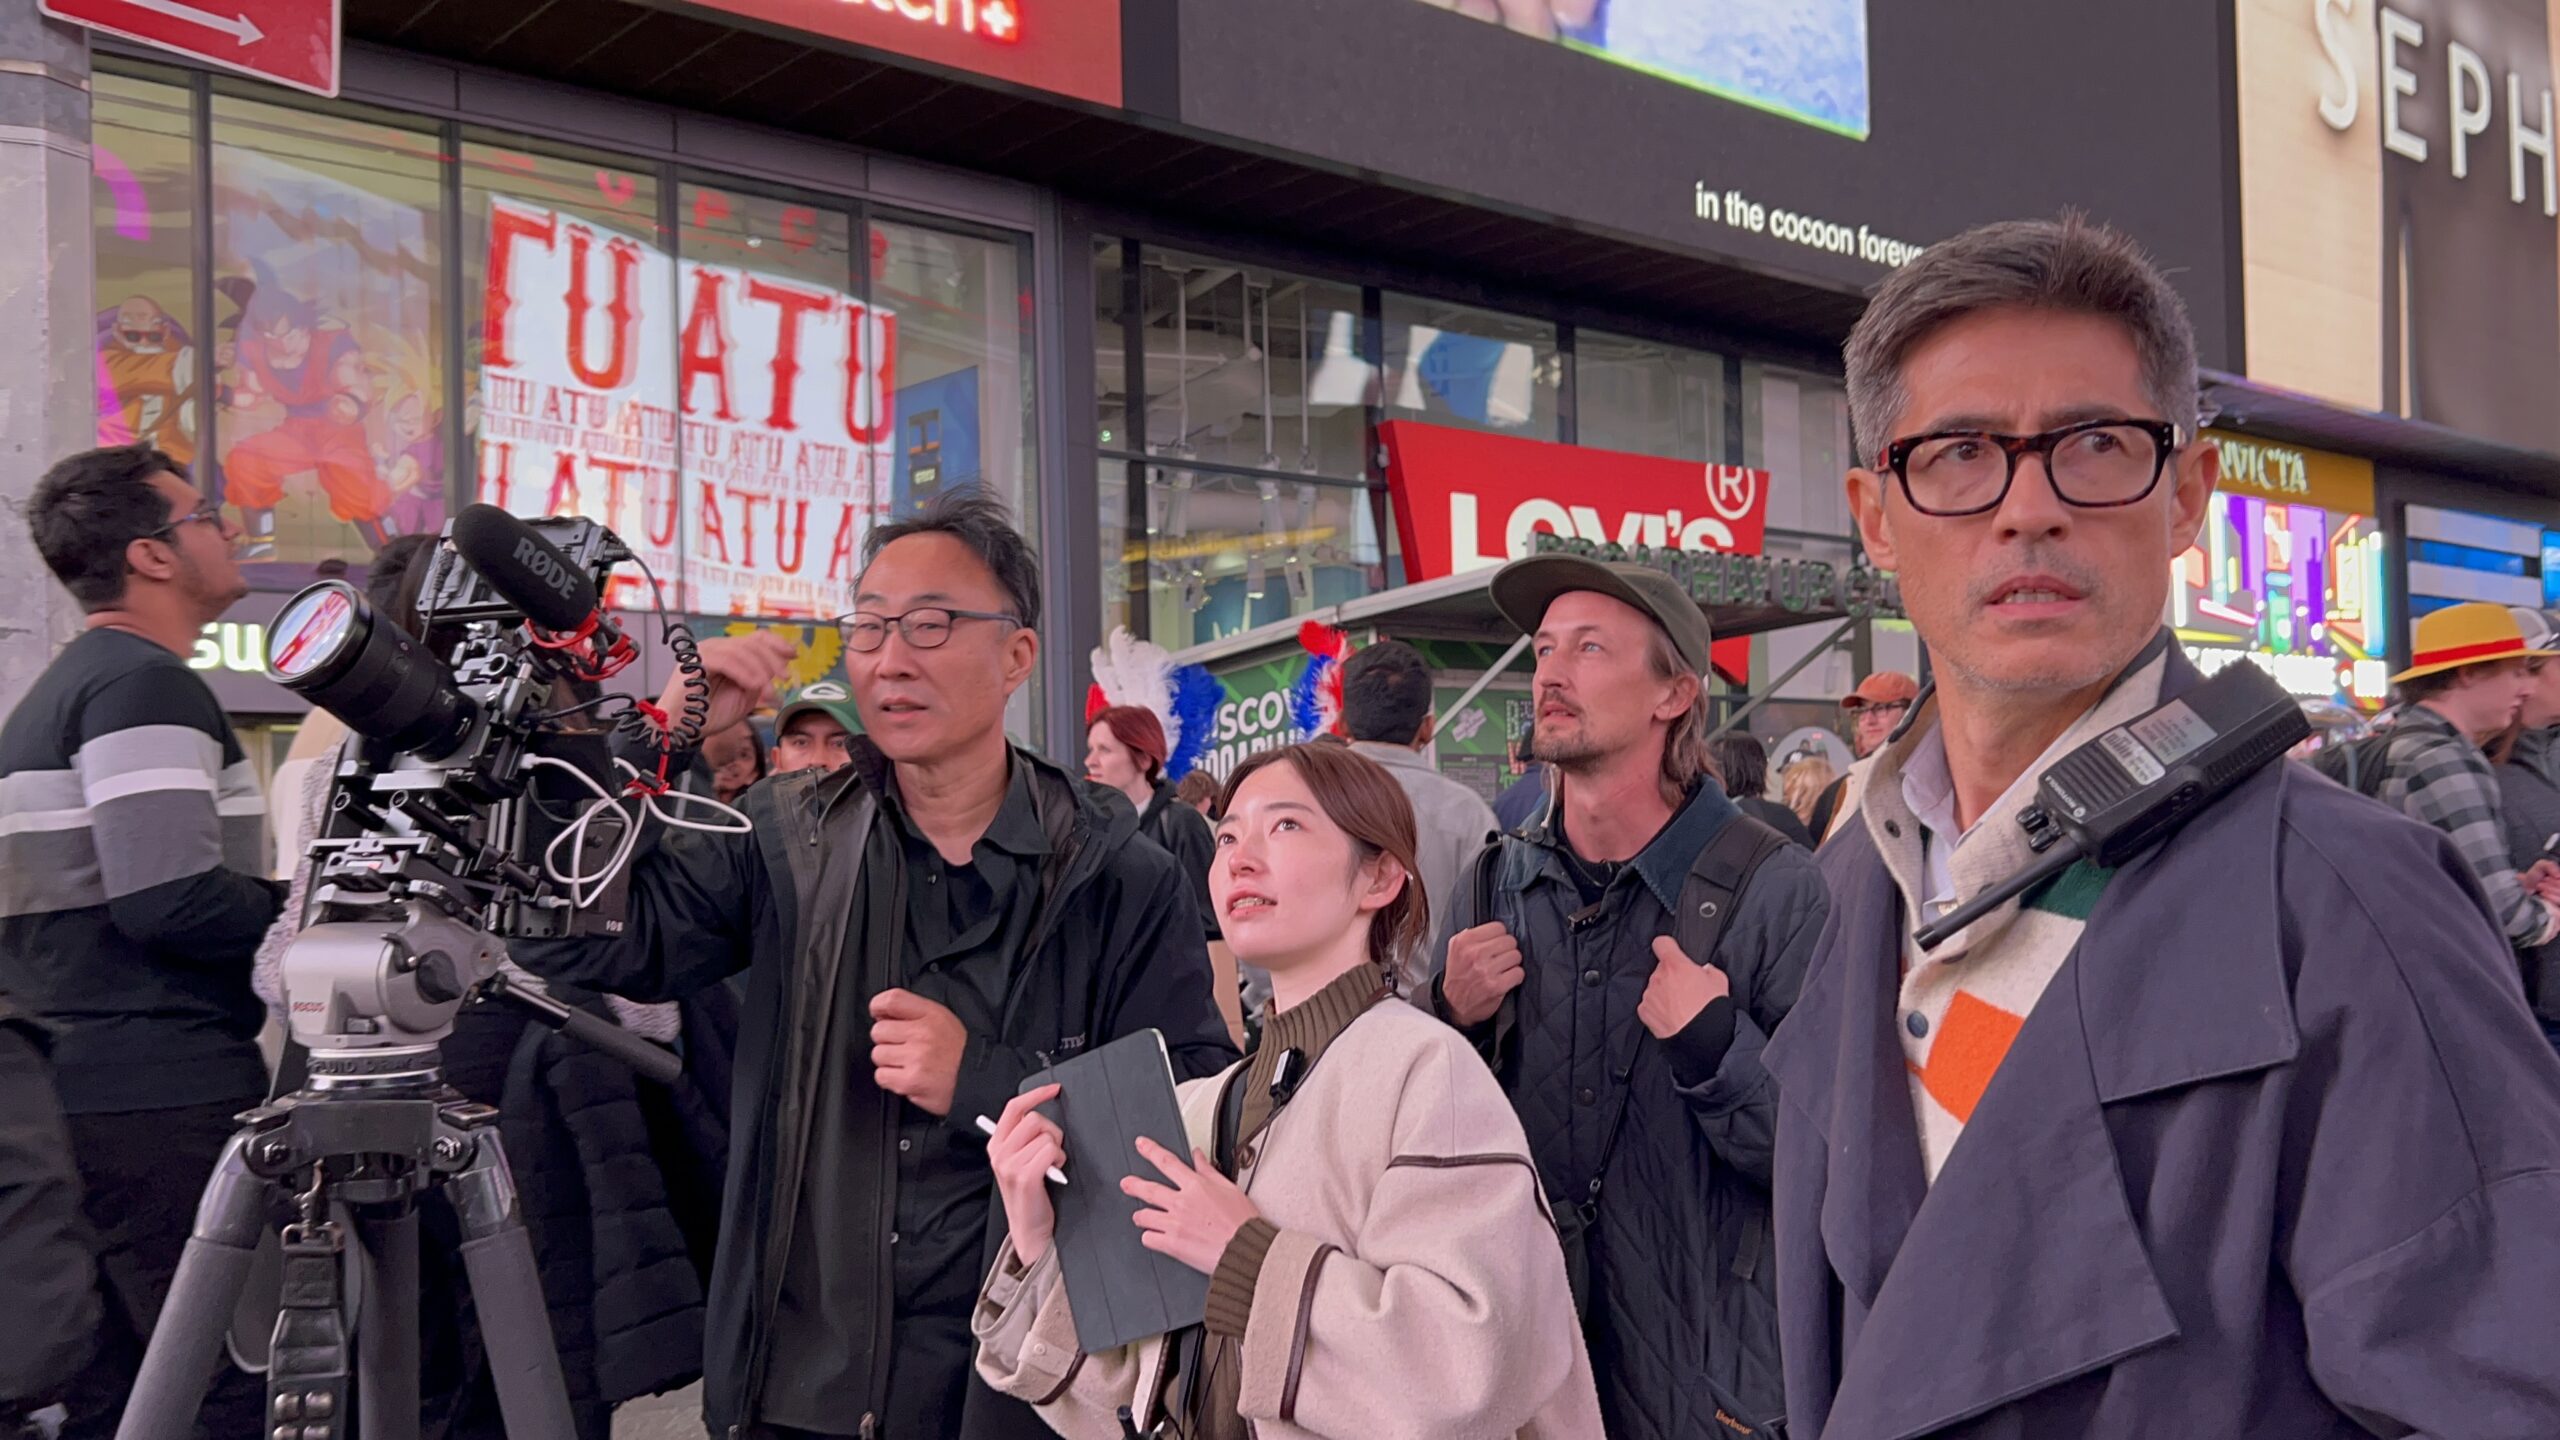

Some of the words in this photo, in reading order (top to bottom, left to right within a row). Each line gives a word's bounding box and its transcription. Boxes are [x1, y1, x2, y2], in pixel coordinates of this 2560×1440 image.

[2314, 0, 2558, 217] SEPH
[1695, 180, 1720, 221] in
[1724, 190, 1766, 232] the
[1769, 208, 1855, 256] cocoon
[2204, 437, 2310, 495] NVICTA
[513, 536, 579, 600] RØDE
